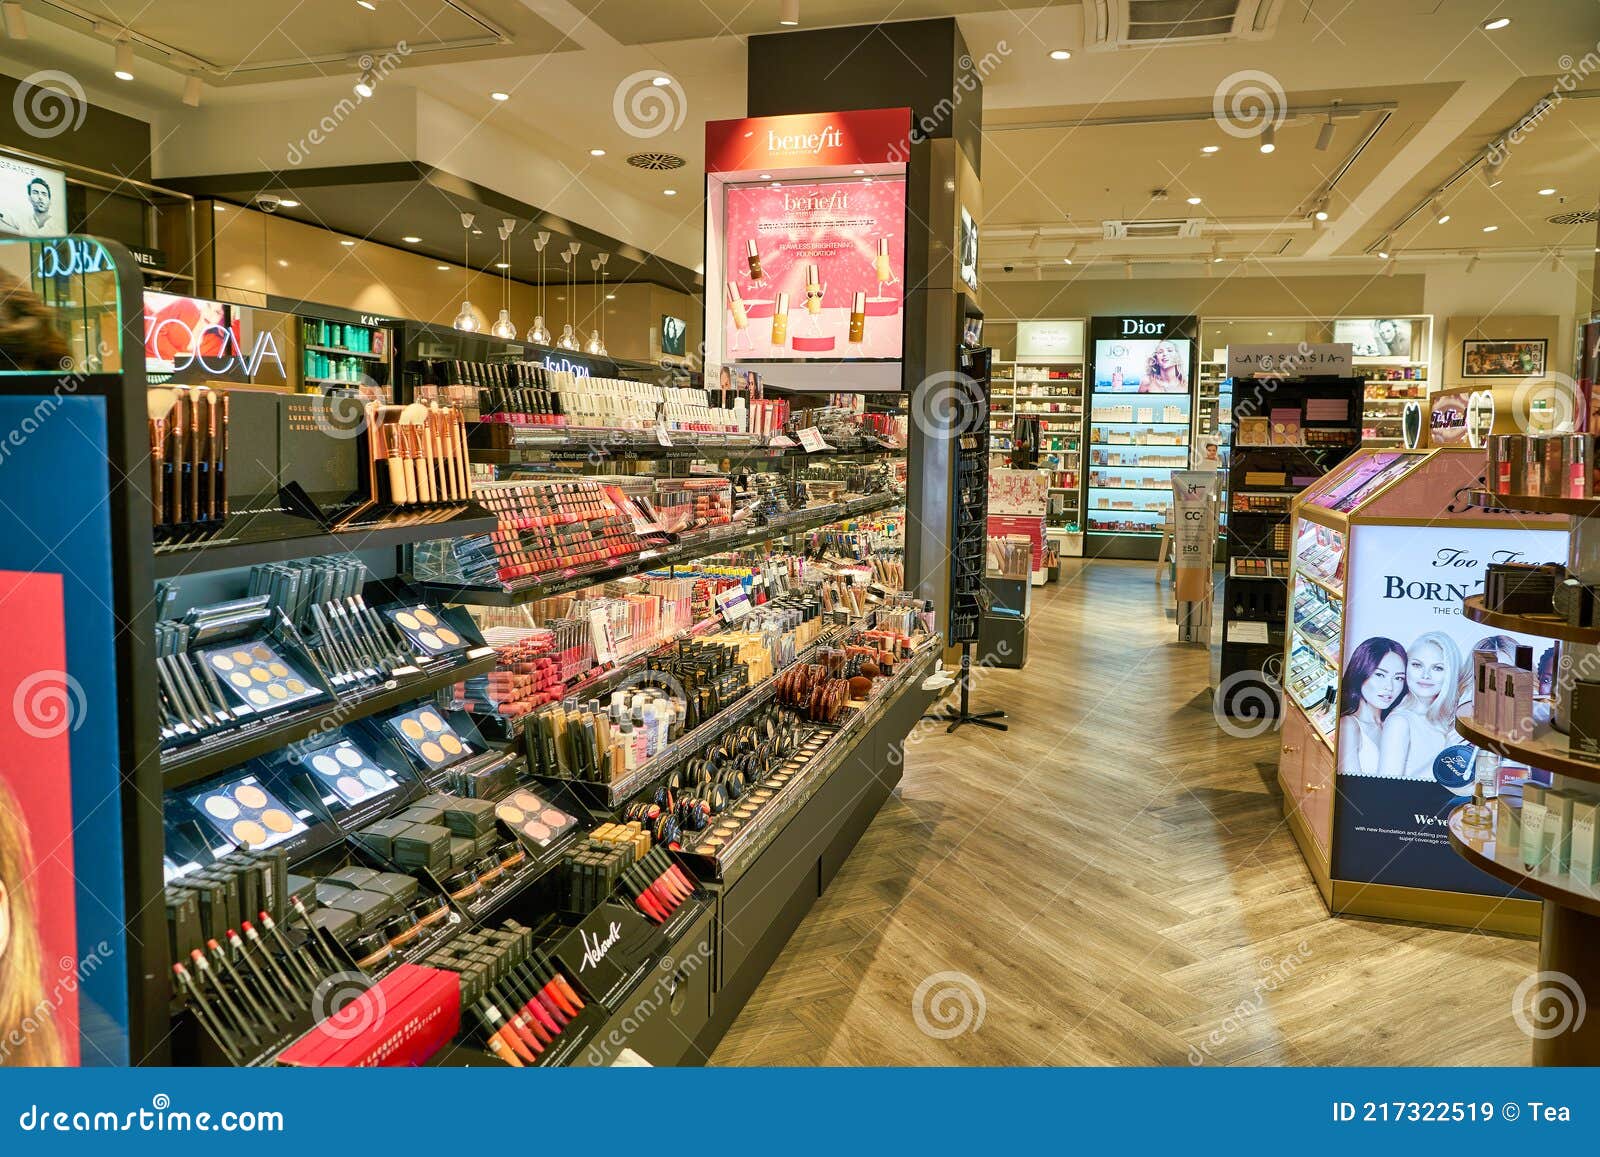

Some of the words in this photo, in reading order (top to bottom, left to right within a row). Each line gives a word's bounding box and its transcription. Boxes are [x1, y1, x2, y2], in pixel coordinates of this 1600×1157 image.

[767, 126, 843, 154] benefit
[783, 191, 848, 212] benefit
[1121, 319, 1165, 334] Dior
[1105, 344, 1130, 358] JOY
[1242, 352, 1338, 364] ANASTASIA
[1432, 548, 1478, 568] Too
[1383, 575, 1470, 602] BORN
[1433, 606, 1451, 615] THE
[1414, 814, 1448, 827] We've
